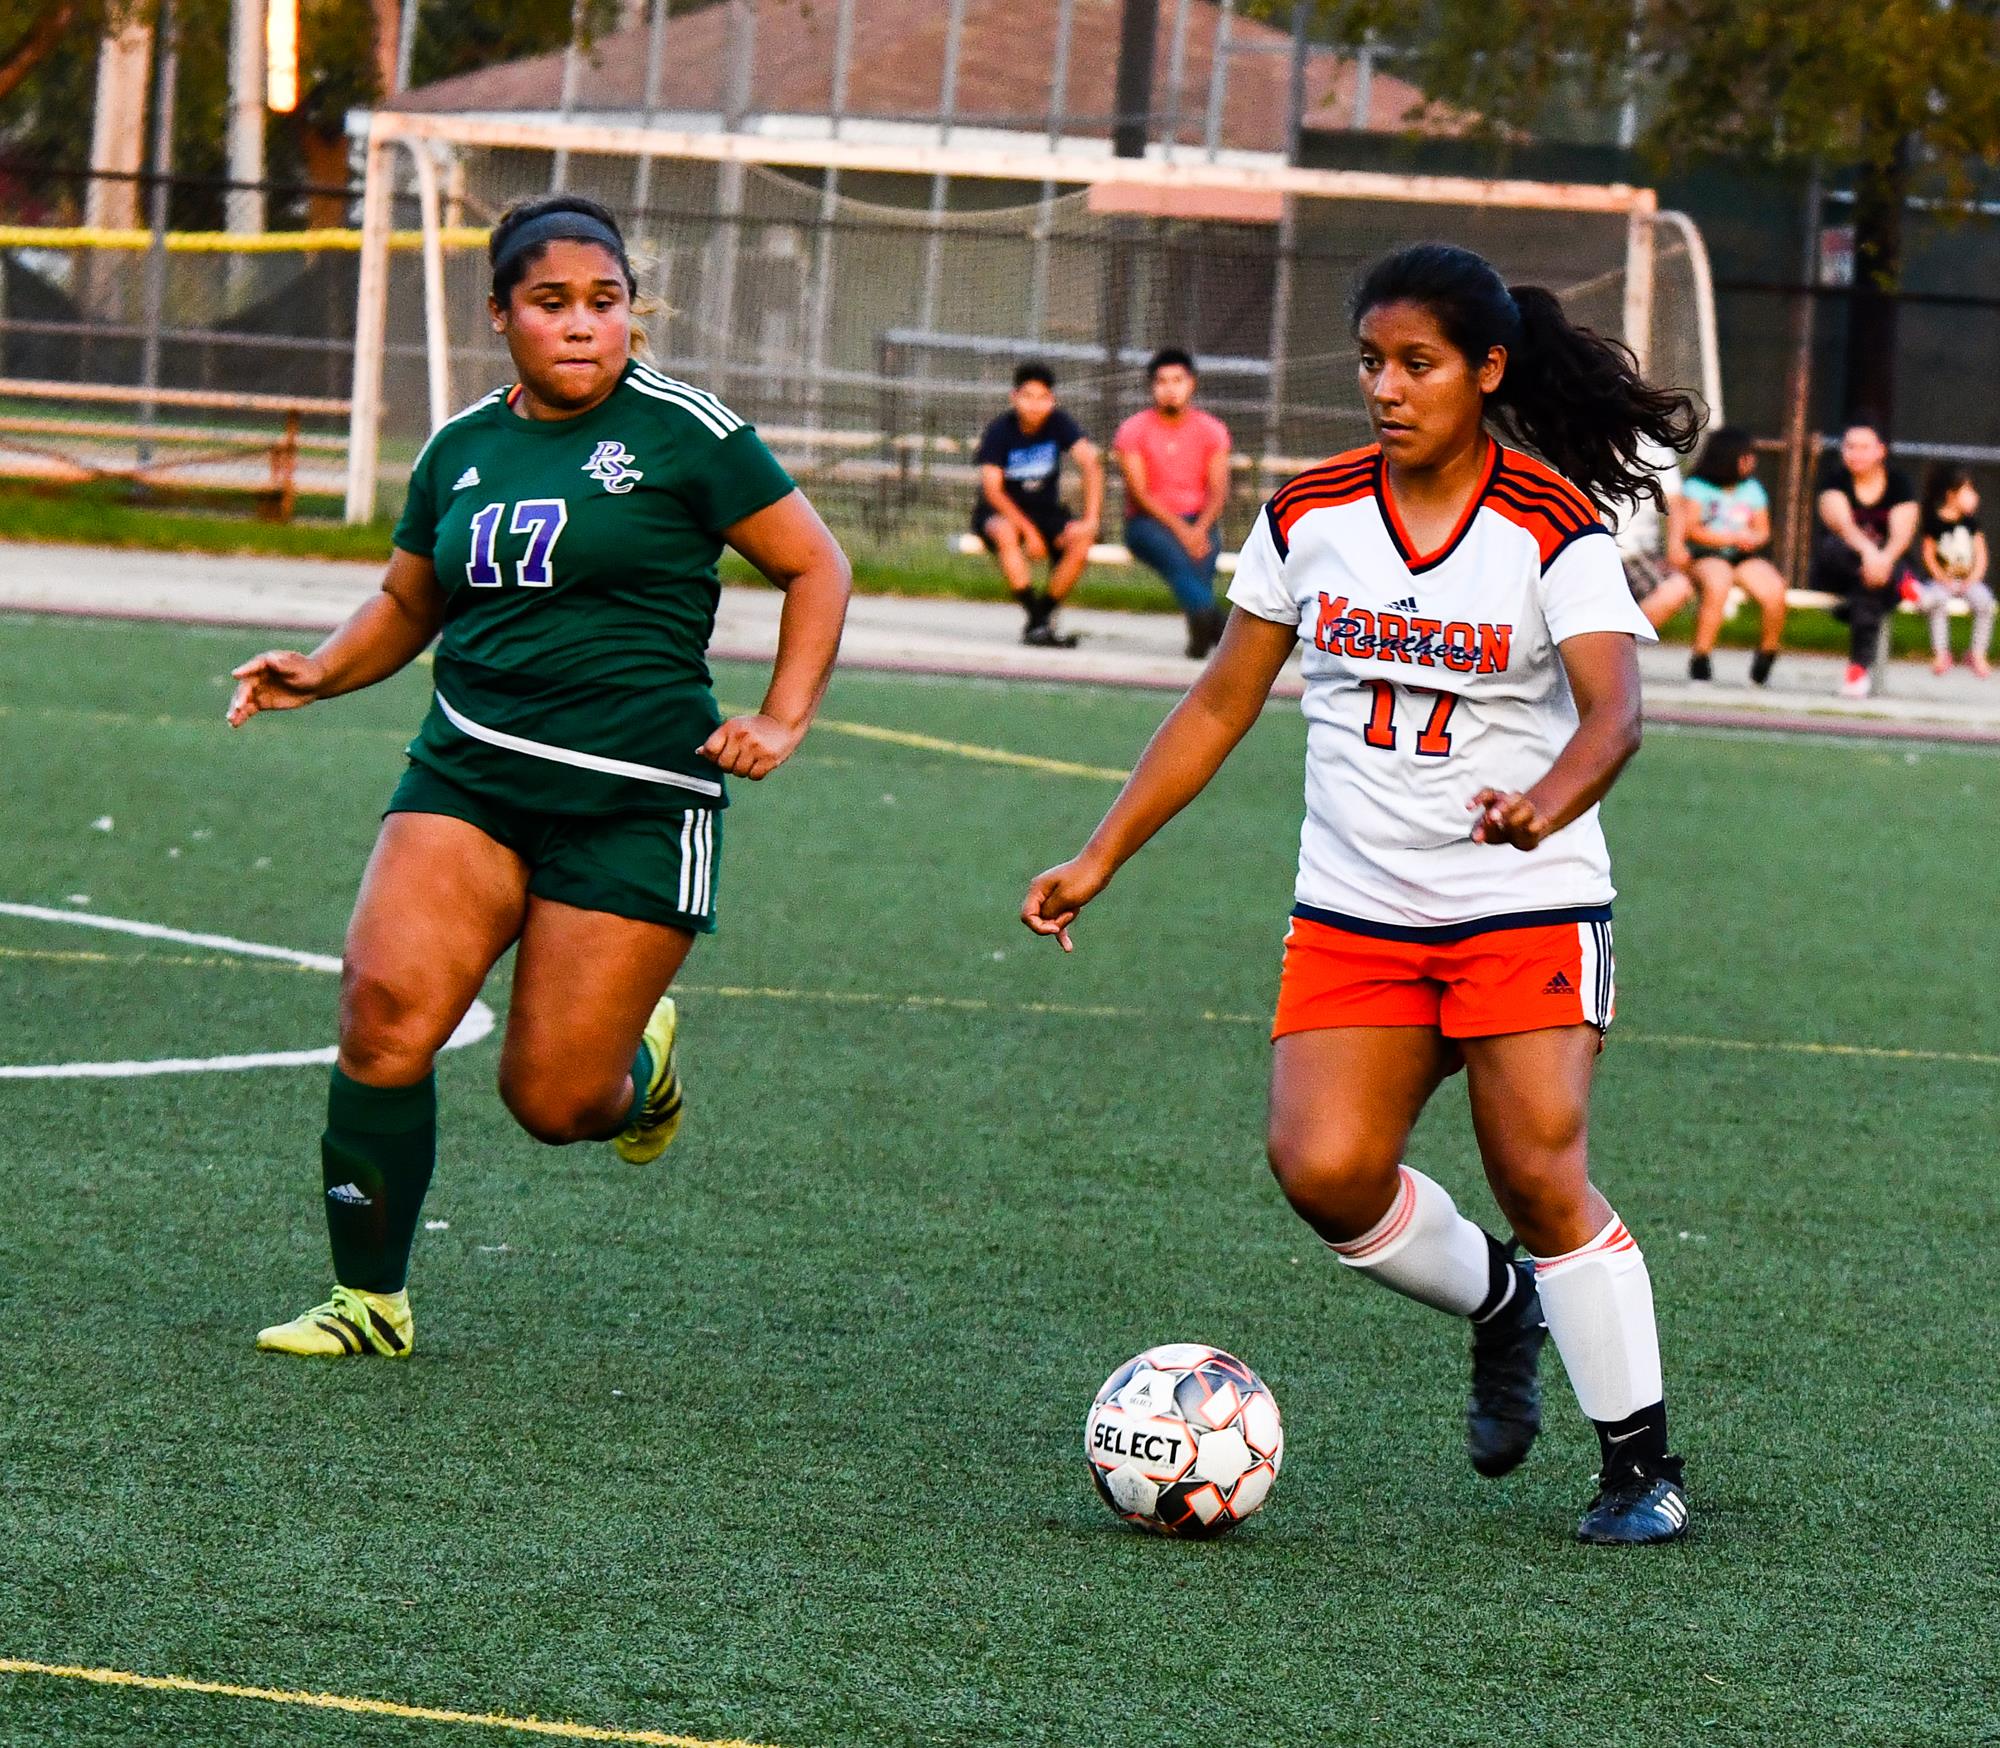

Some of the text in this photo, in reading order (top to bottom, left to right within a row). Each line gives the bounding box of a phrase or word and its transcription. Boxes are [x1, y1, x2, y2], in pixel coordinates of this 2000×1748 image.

[466, 499, 568, 587] 17
[1314, 591, 1512, 674] MORTON
[1331, 617, 1483, 661] Panthers
[1358, 678, 1460, 757] 17
[1094, 1422, 1182, 1465] SELECT
